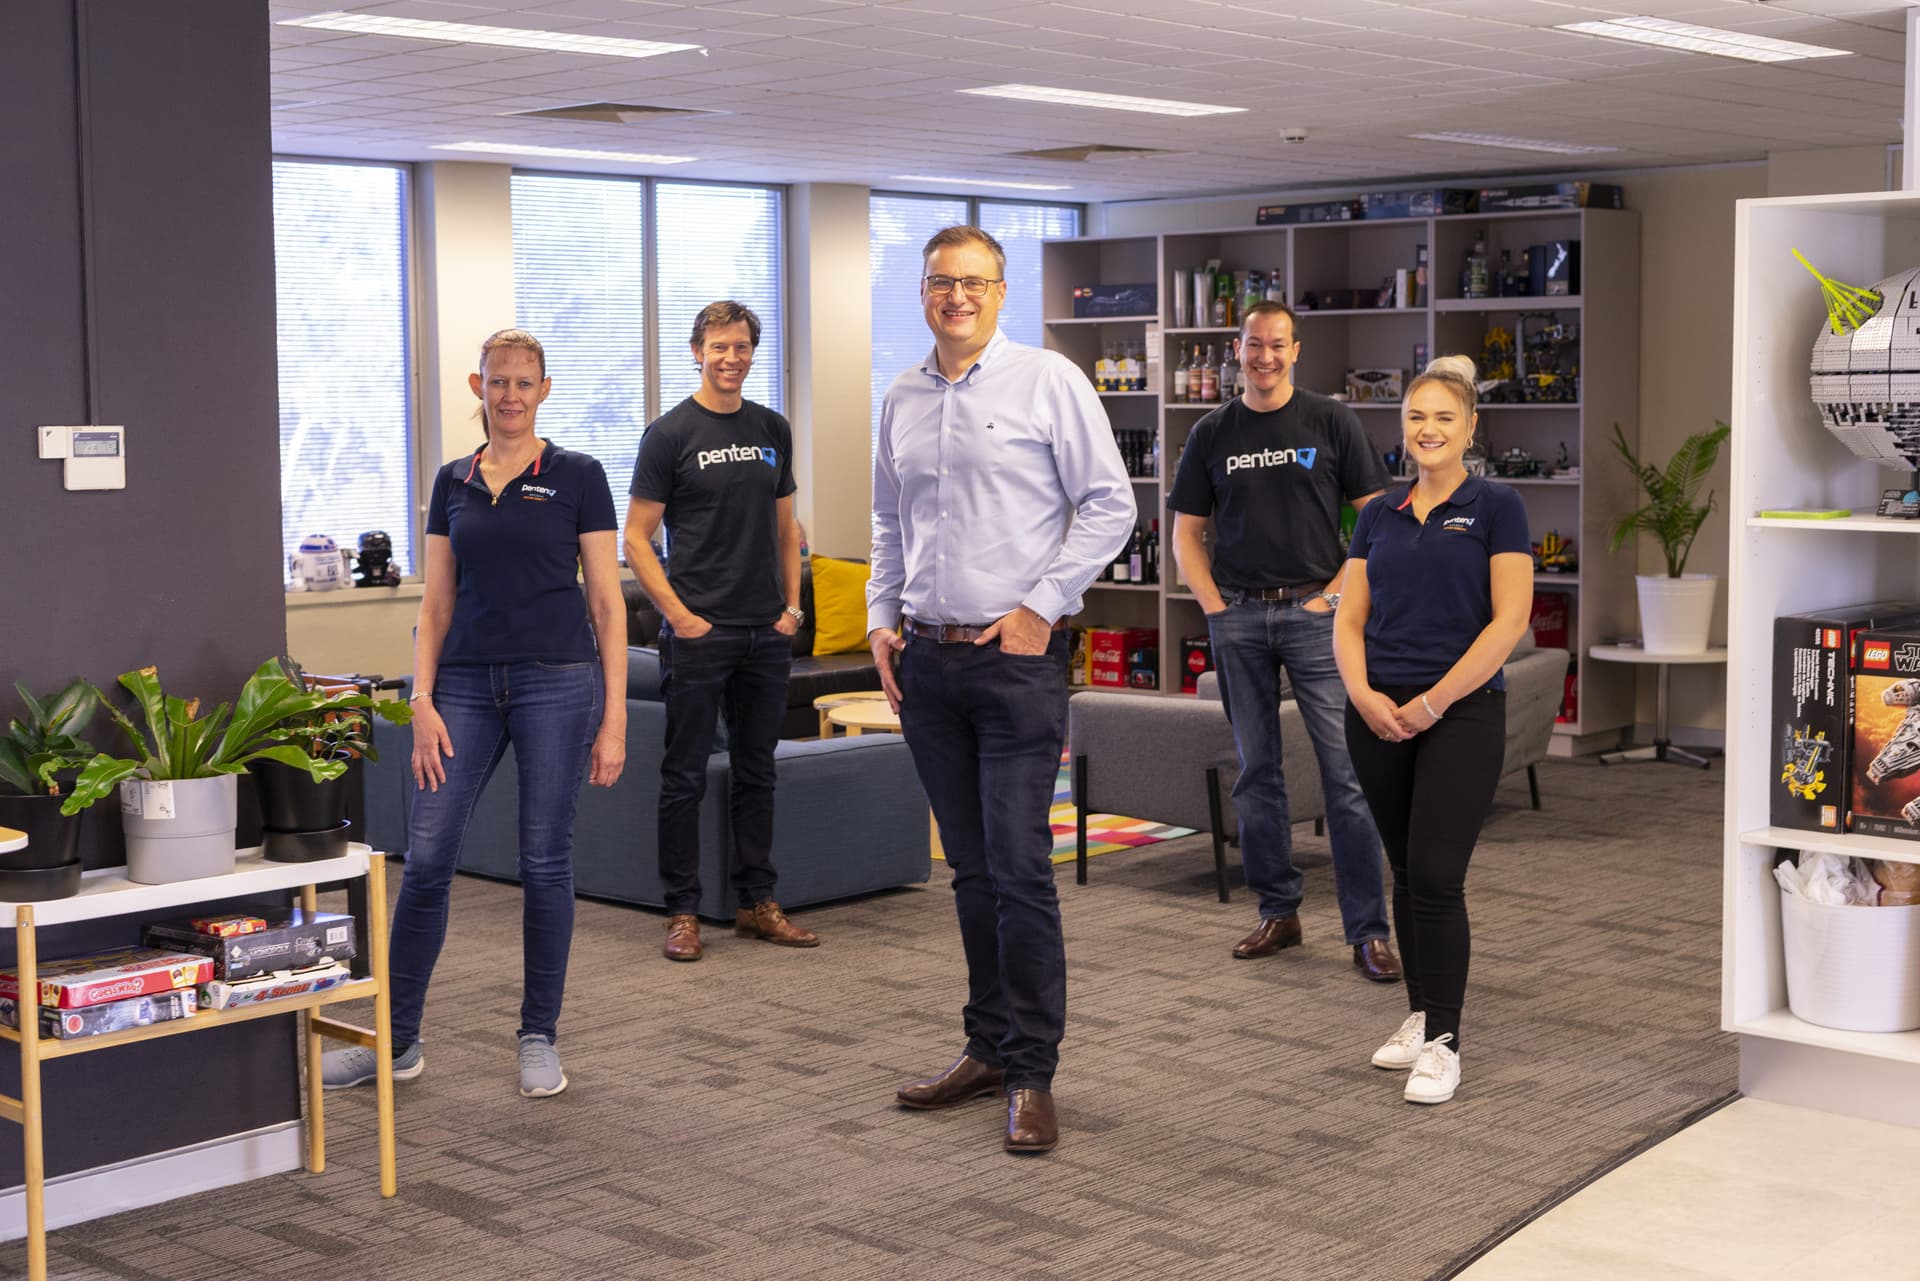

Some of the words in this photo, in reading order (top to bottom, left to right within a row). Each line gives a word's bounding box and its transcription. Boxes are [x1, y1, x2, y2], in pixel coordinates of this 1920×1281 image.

[697, 443, 764, 470] penten
[1226, 447, 1297, 475] penten
[521, 484, 550, 494] penten
[1865, 648, 1889, 661] LEGO
[1826, 651, 1836, 707] TECHNIC
